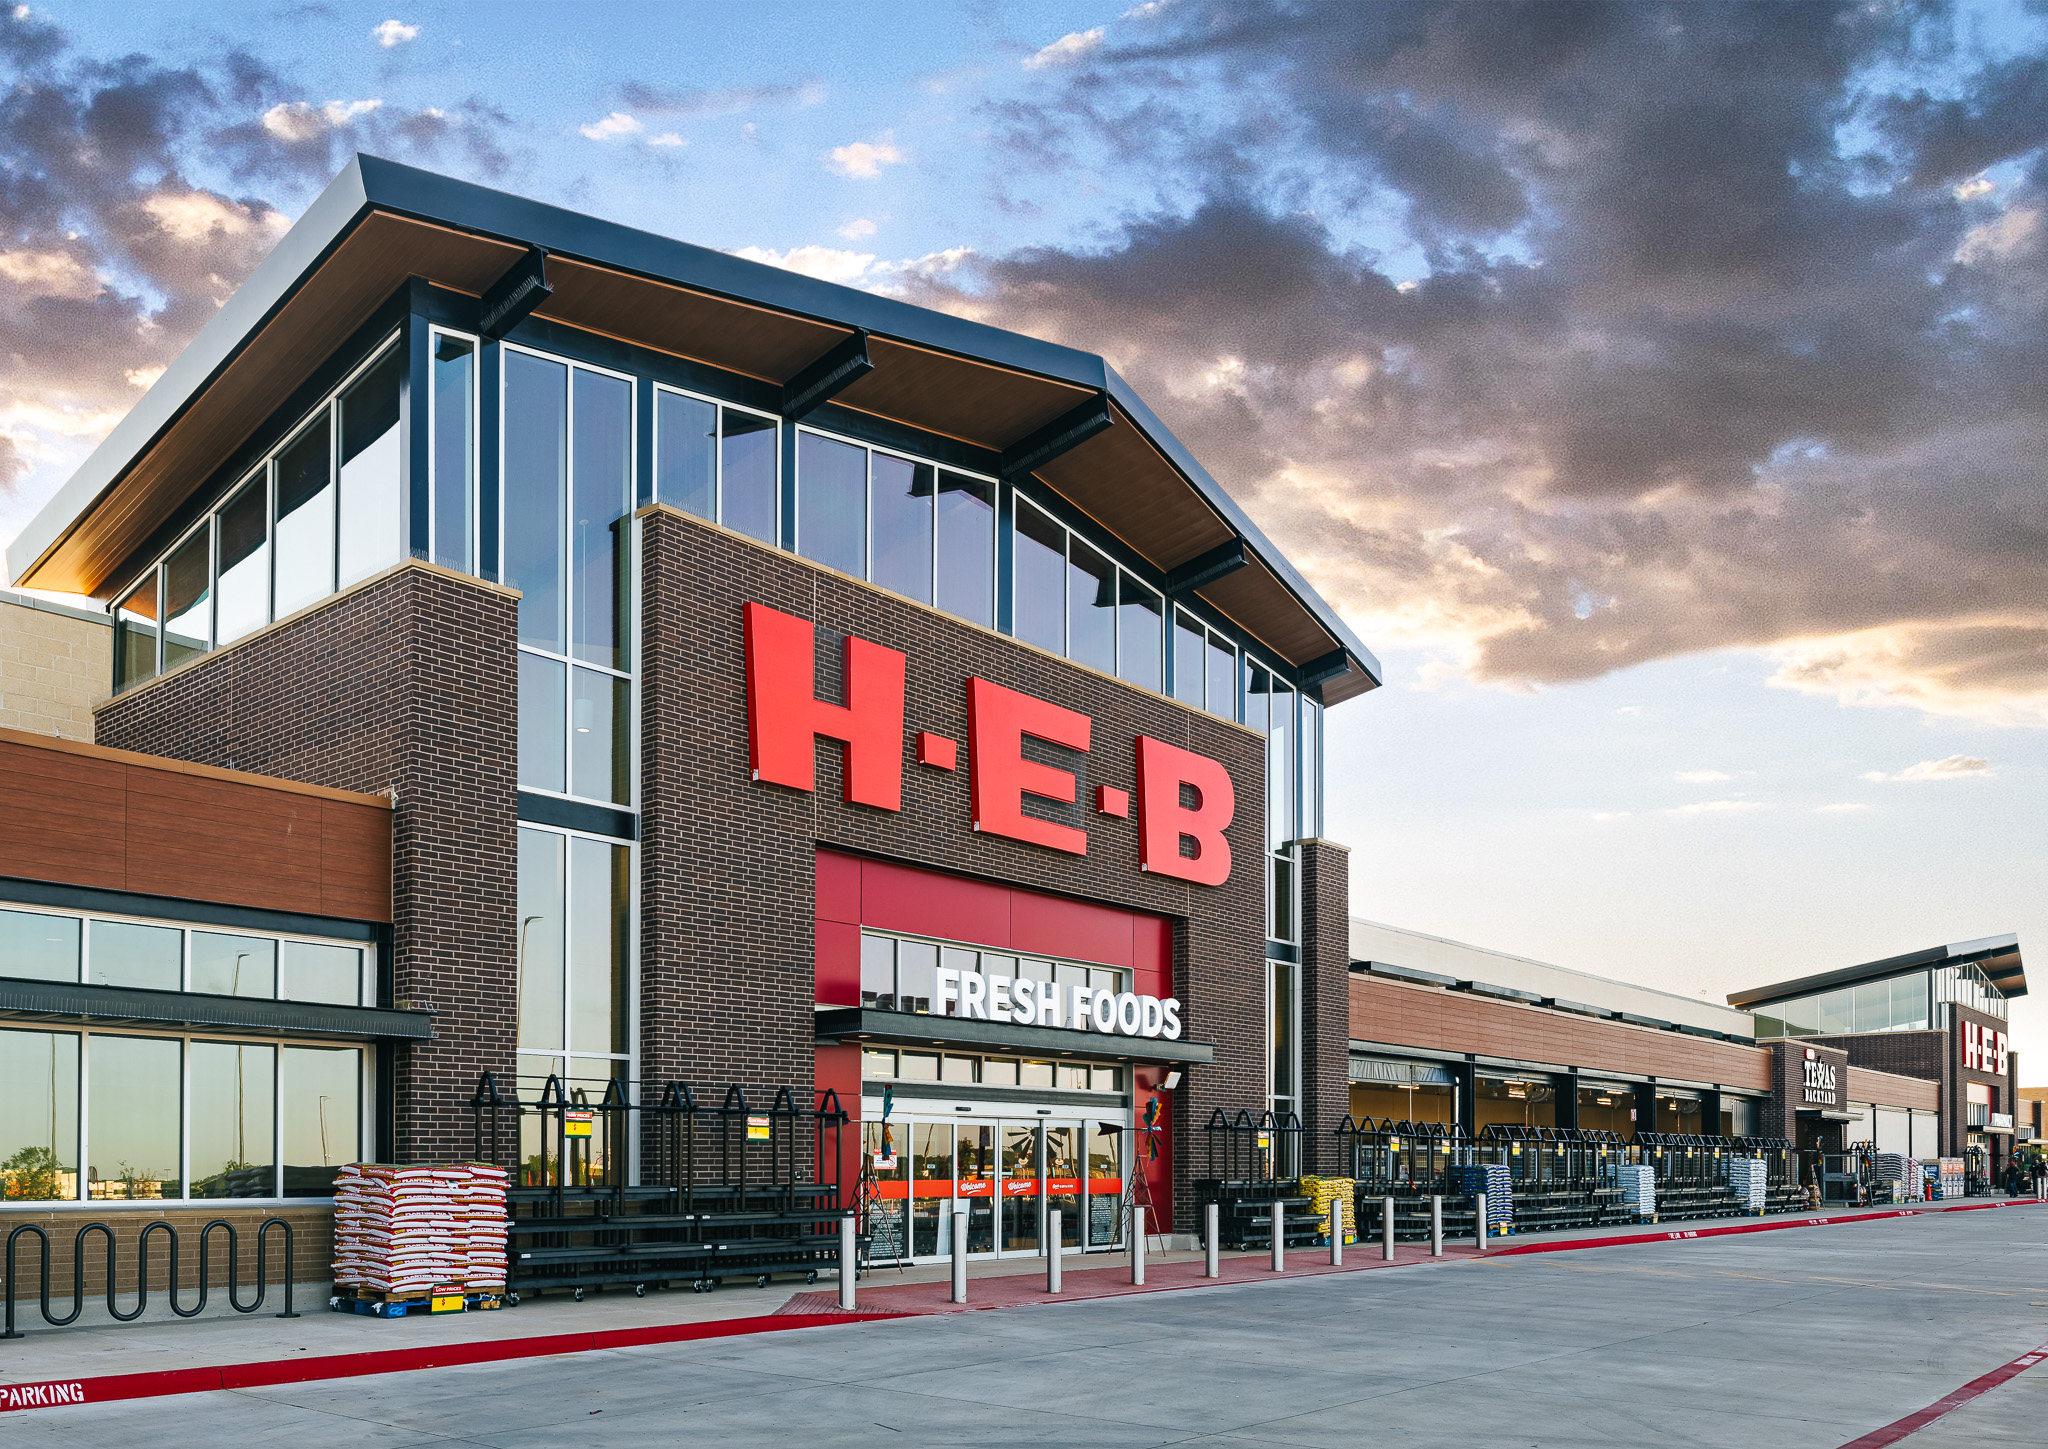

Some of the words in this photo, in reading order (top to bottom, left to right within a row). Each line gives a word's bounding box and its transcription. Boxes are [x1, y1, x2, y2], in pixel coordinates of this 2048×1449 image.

[930, 967, 1060, 1027] FRESH
[1066, 985, 1181, 1040] FOODS
[1802, 1057, 1836, 1090] TEXAS
[1803, 1088, 1836, 1104] BACKYARD
[961, 1182, 987, 1191] Welcome
[1008, 1181, 1032, 1191] Welcome
[0, 1383, 85, 1408] PARKING
